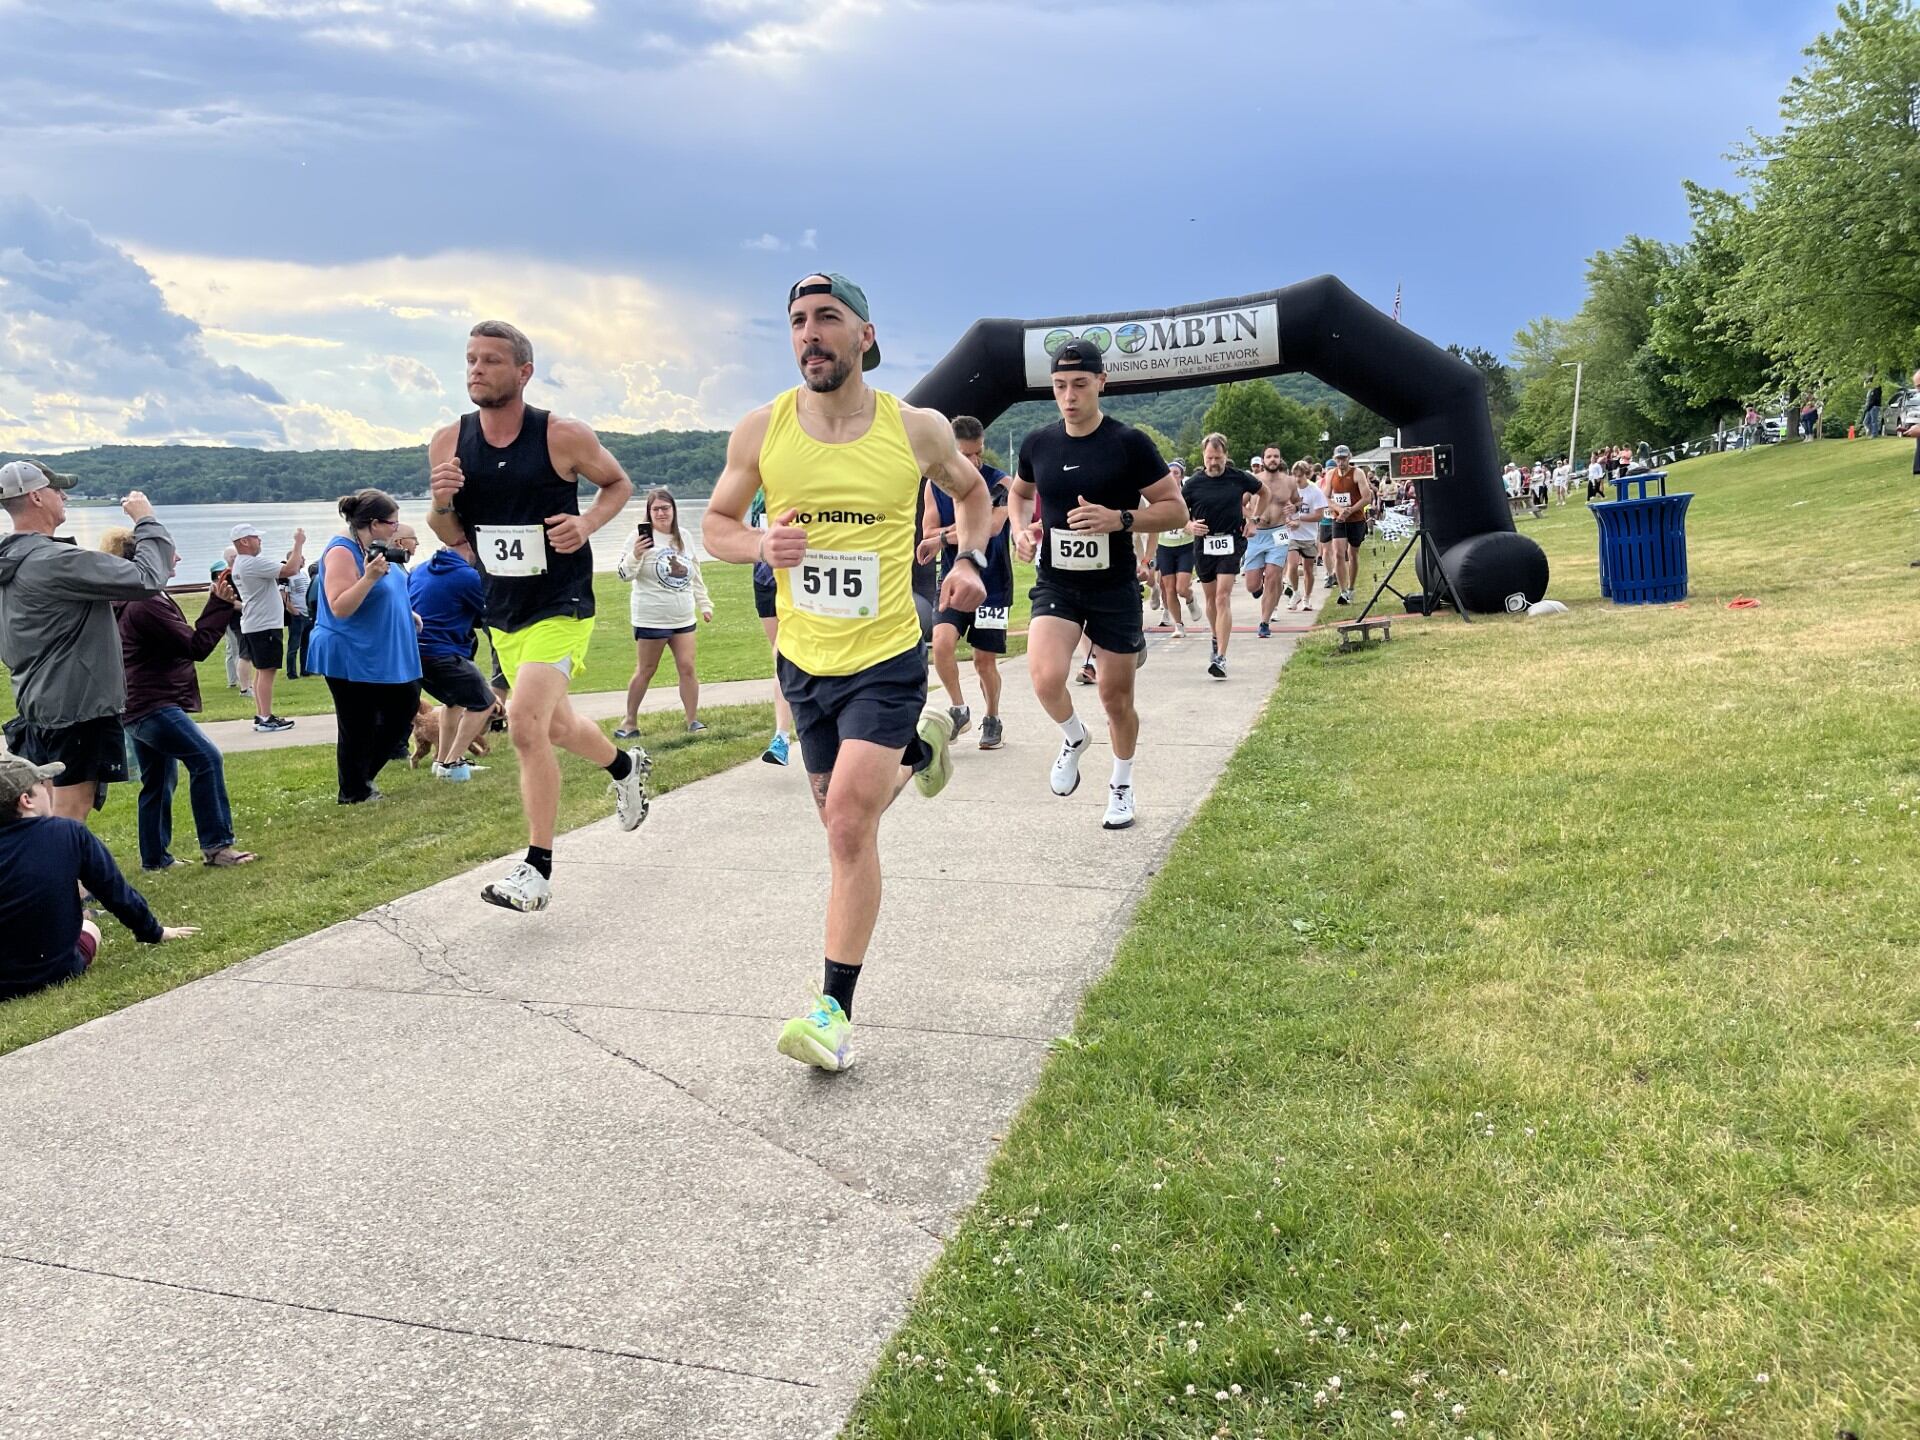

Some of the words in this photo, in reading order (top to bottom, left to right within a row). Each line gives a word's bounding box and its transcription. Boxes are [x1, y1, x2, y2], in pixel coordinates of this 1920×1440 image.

[1148, 310, 1259, 351] MBTN
[1151, 357, 1170, 369] BAY
[1173, 354, 1203, 367] TRAIL
[1204, 347, 1259, 363] NETWORK
[494, 538, 525, 561] 34
[1060, 539, 1099, 558] 520
[1208, 539, 1229, 550] 105
[803, 565, 862, 598] 515
[978, 606, 1005, 620] 542
